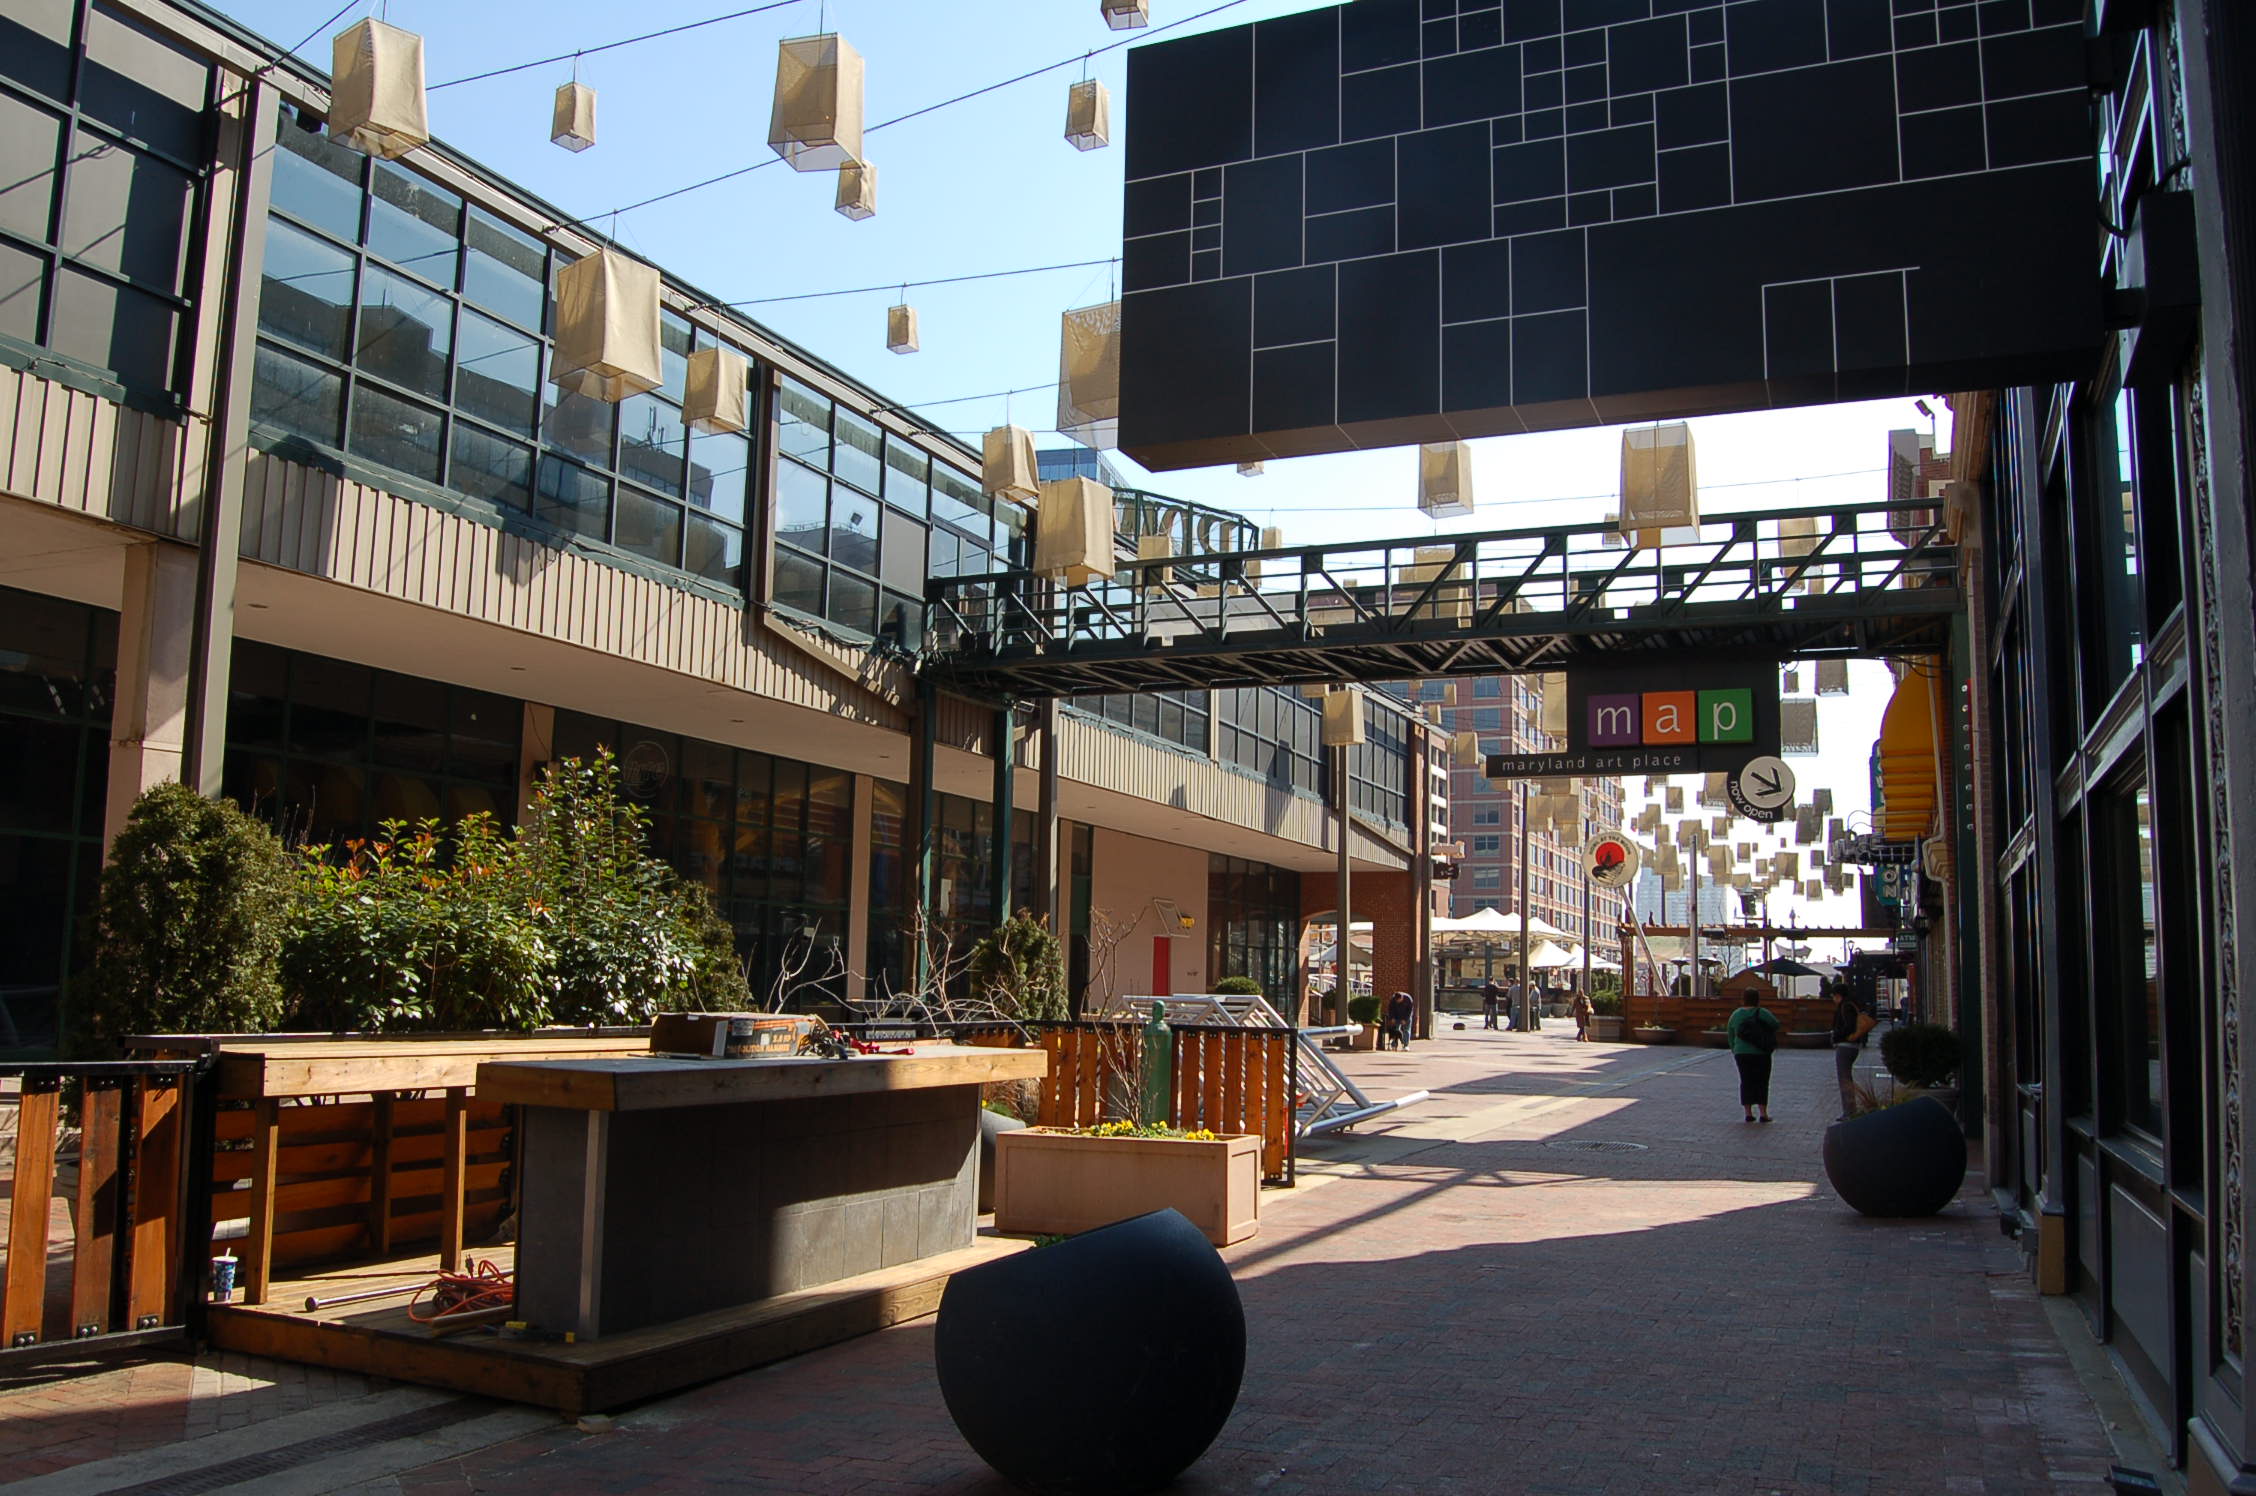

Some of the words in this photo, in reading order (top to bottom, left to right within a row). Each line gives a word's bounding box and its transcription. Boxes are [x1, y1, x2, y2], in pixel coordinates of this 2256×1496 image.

[1596, 700, 1738, 740] map
[1502, 756, 1585, 773] maryland
[1596, 755, 1623, 768] art
[1633, 753, 1681, 769] place
[1730, 780, 1745, 804] now
[1743, 804, 1774, 819] open
